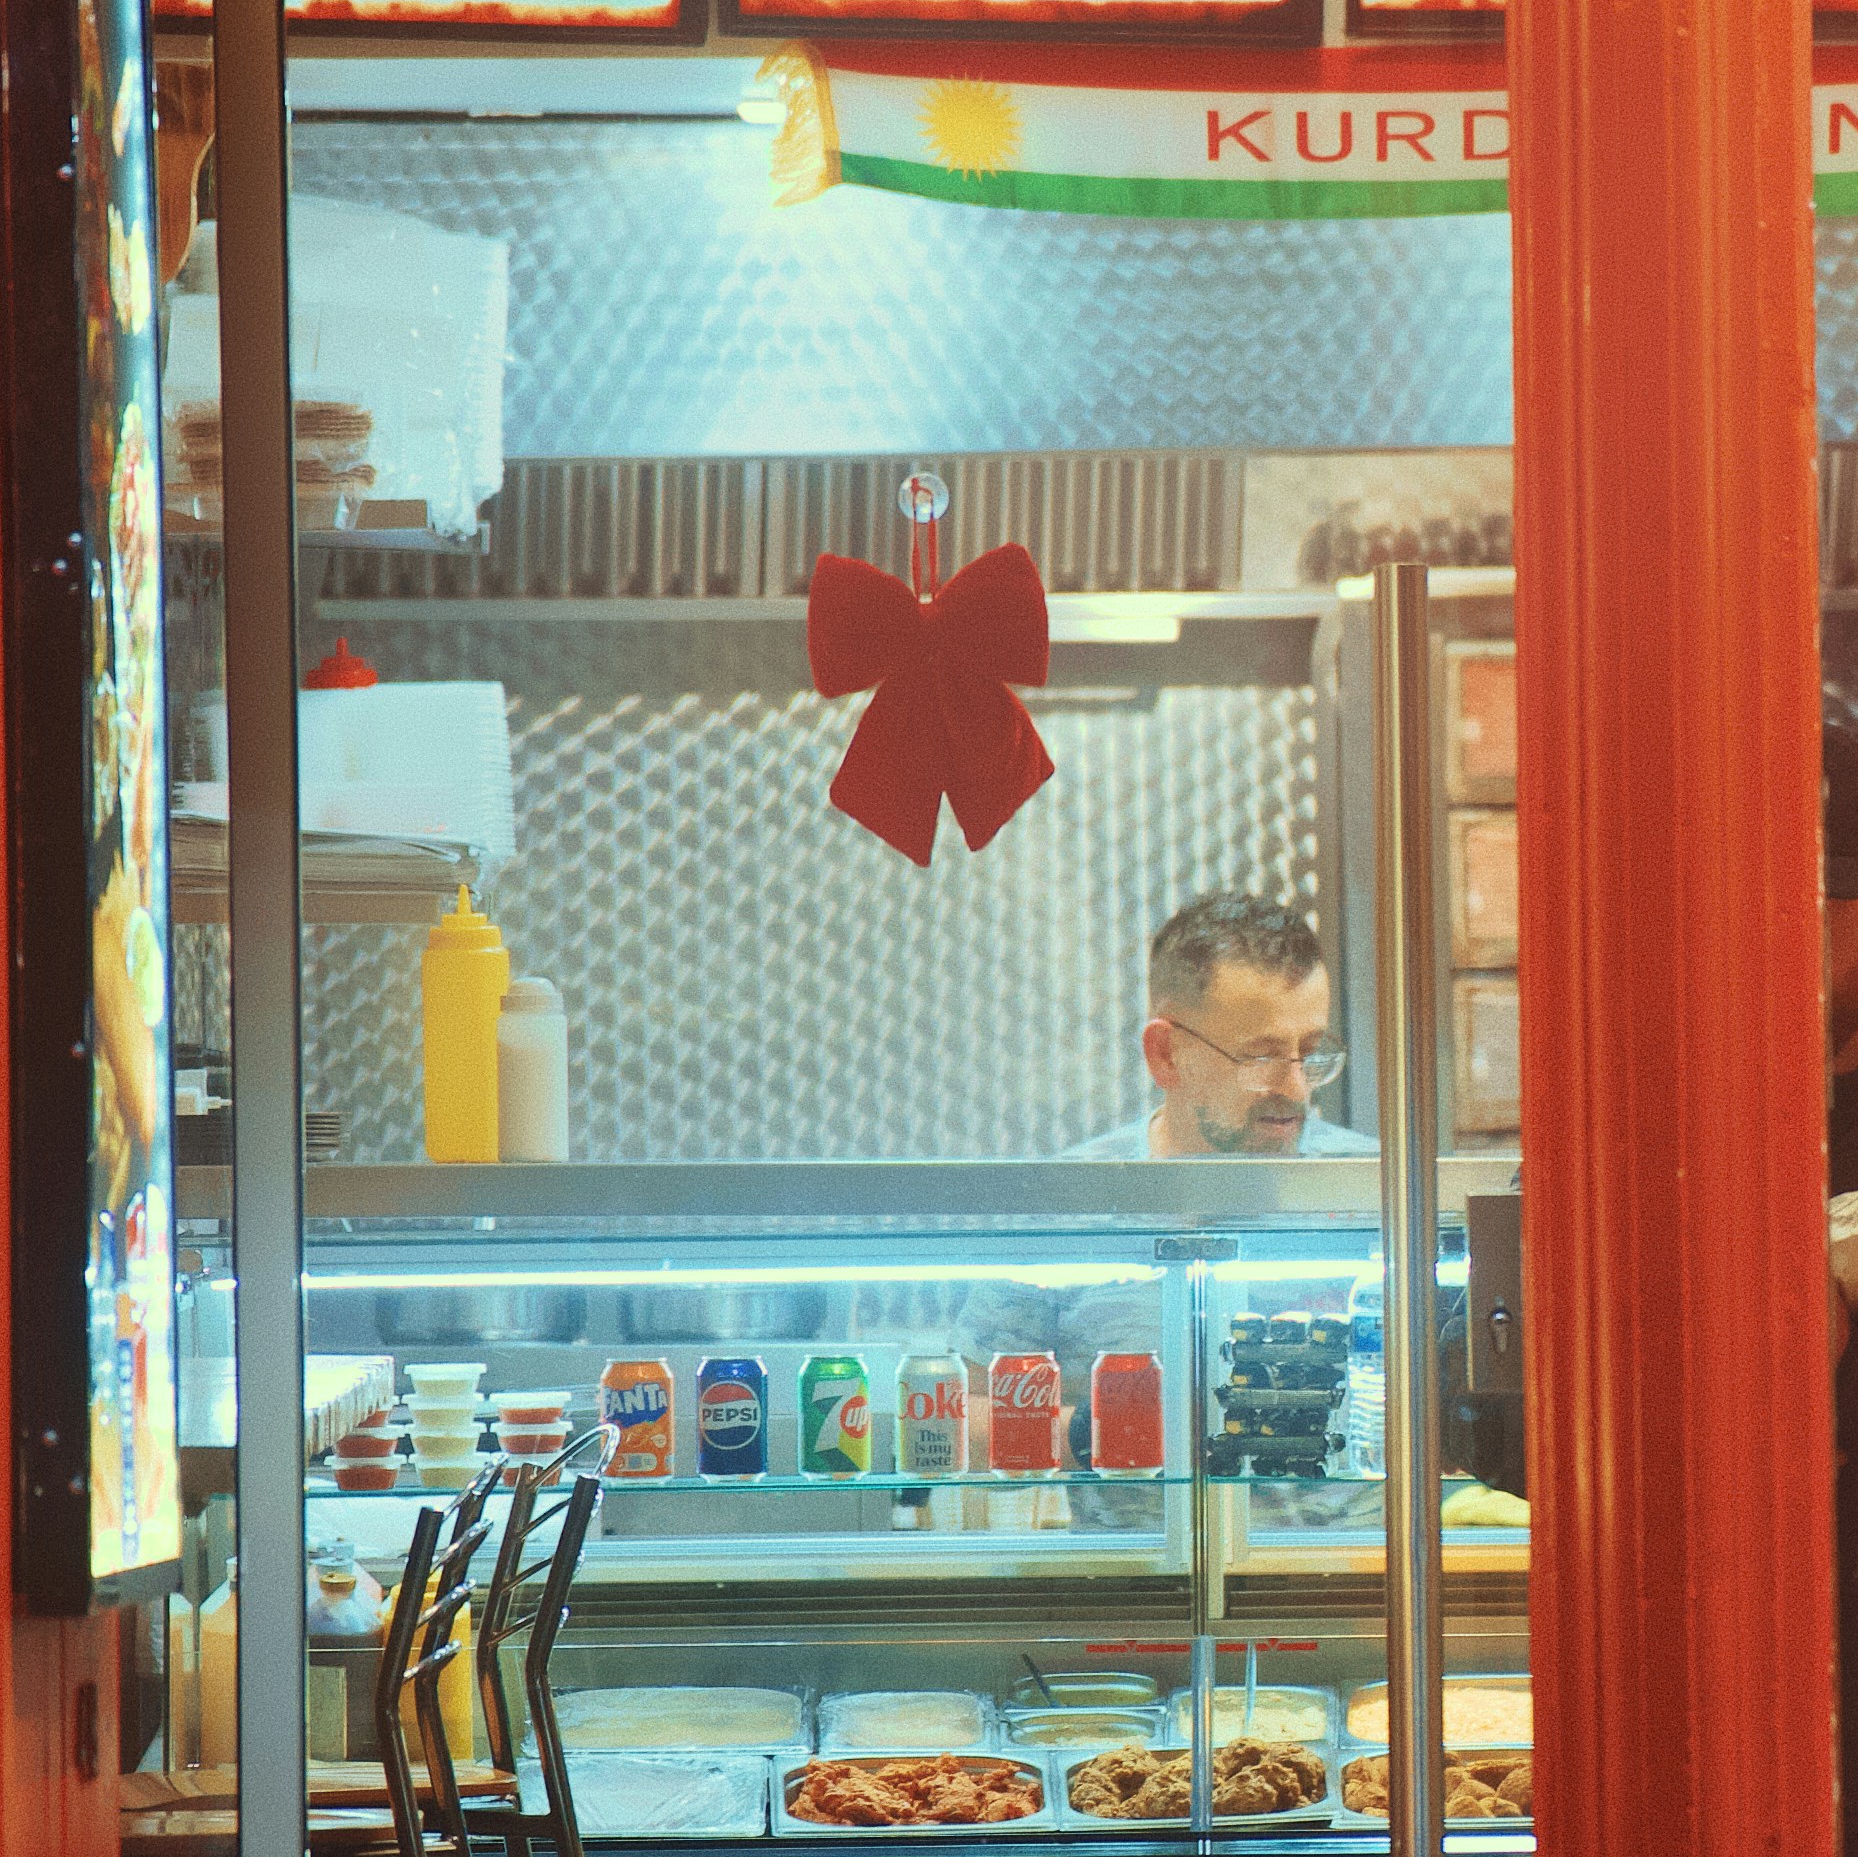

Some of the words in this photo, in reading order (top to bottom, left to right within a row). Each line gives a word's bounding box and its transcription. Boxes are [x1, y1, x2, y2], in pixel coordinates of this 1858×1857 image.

[603, 1382, 669, 1416] FANTA
[702, 1406, 758, 1423] PEPSI
[811, 1378, 861, 1453] 7
[917, 1428, 949, 1442] This
